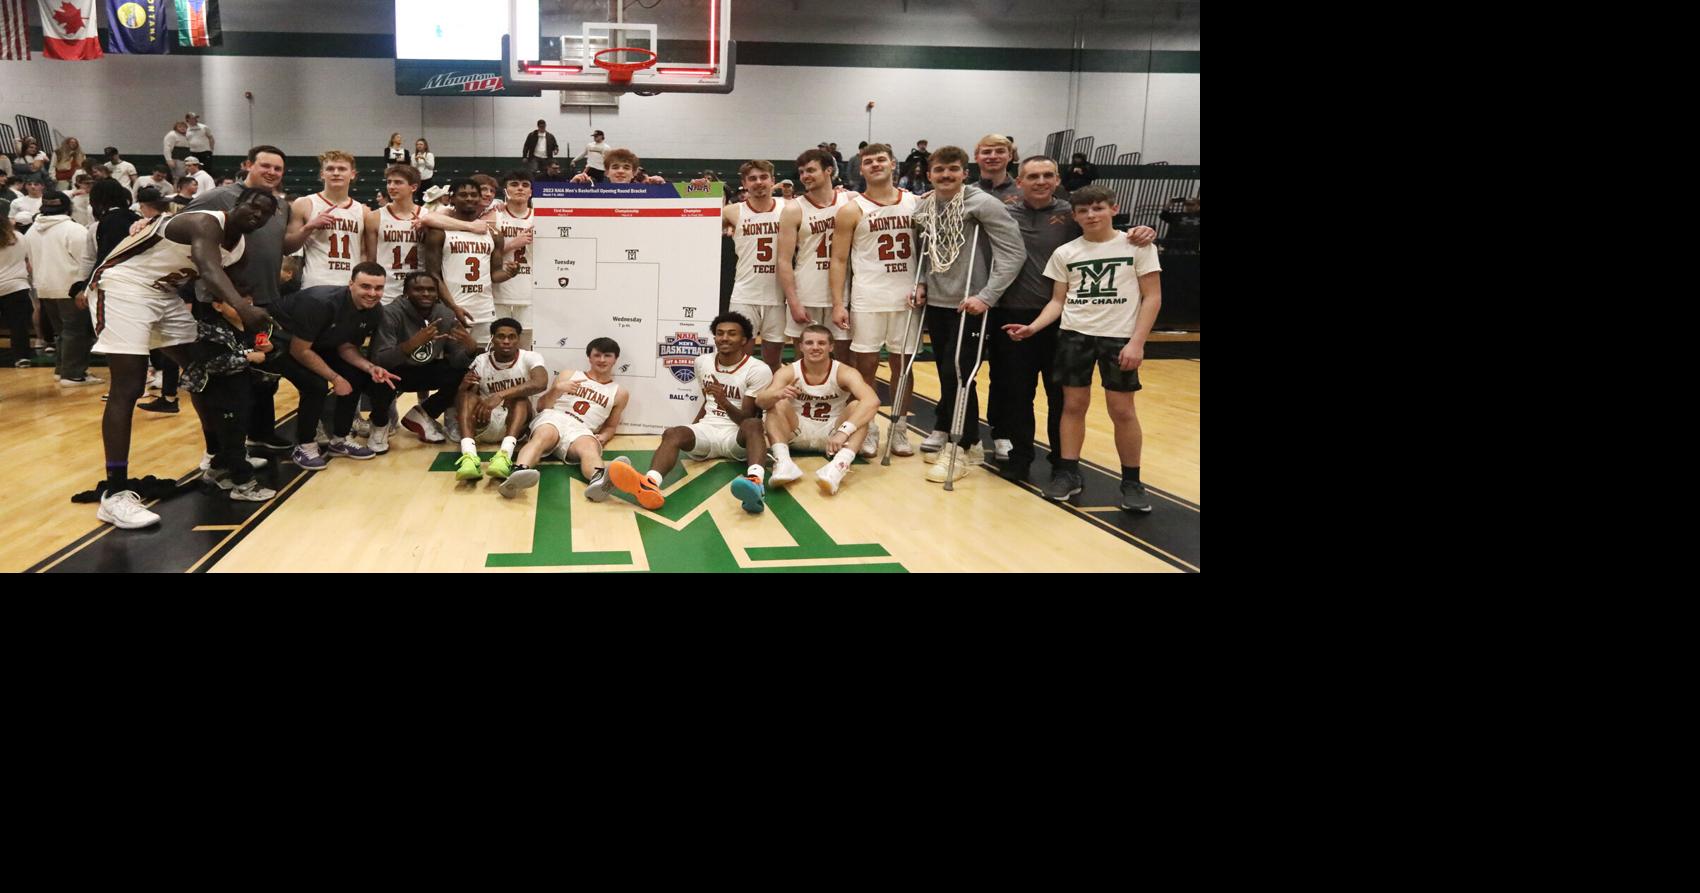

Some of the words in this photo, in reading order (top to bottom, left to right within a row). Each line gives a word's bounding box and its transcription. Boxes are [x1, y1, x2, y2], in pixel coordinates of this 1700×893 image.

[742, 222, 780, 236] MONTAN
[328, 233, 351, 260] 11
[449, 241, 491, 255] MONTANA
[756, 237, 773, 262] 5
[877, 233, 912, 261] 23
[391, 245, 418, 270] 14
[328, 261, 351, 271] TECH
[464, 256, 481, 282] 3
[753, 264, 776, 274] TECH
[884, 263, 908, 273] TECH
[461, 284, 483, 293] TECH
[612, 316, 642, 324] Wednesday
[676, 332, 698, 340] NAIA
[572, 400, 591, 416] 0
[801, 402, 832, 418] 12
